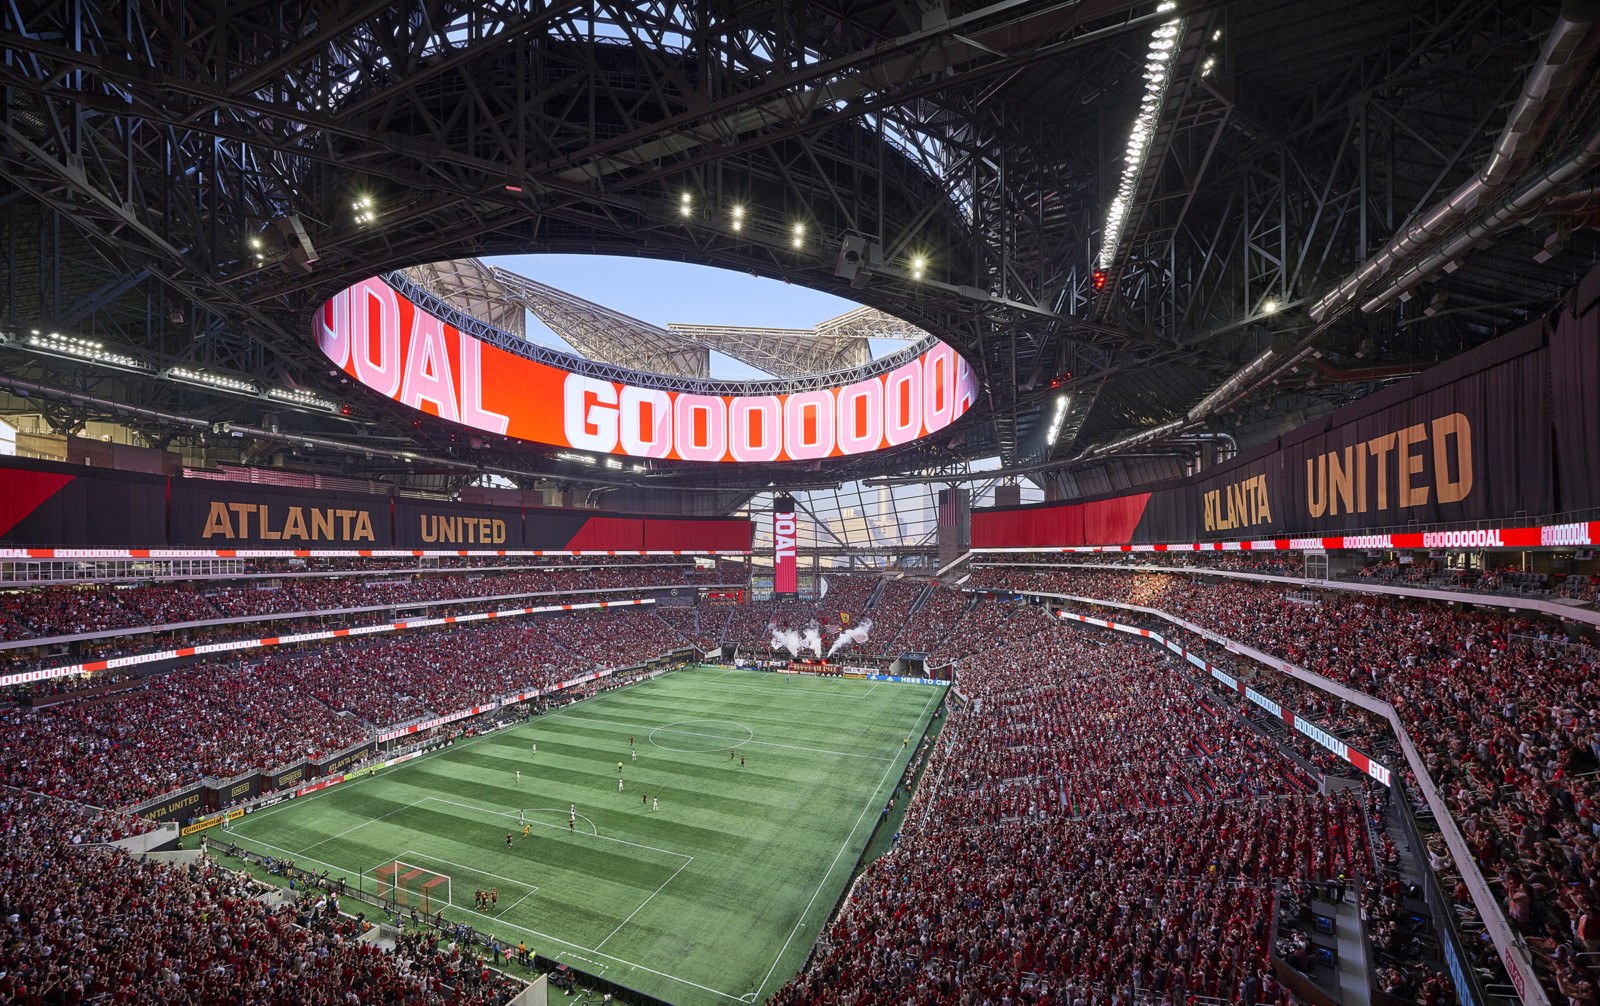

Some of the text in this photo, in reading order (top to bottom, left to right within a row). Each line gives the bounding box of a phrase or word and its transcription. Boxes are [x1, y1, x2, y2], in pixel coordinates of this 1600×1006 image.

[1307, 412, 1473, 518] UNITED
[1203, 473, 1272, 532] ATLANTA
[202, 501, 506, 544] ATLANTA UNITED
[1423, 529, 1504, 547] GOOOOOOOAL
[1541, 522, 1591, 546] GOOOOOOOAL
[0, 664, 87, 687] OOOOOOOAL
[144, 794, 199, 820] ANTA UNITED
